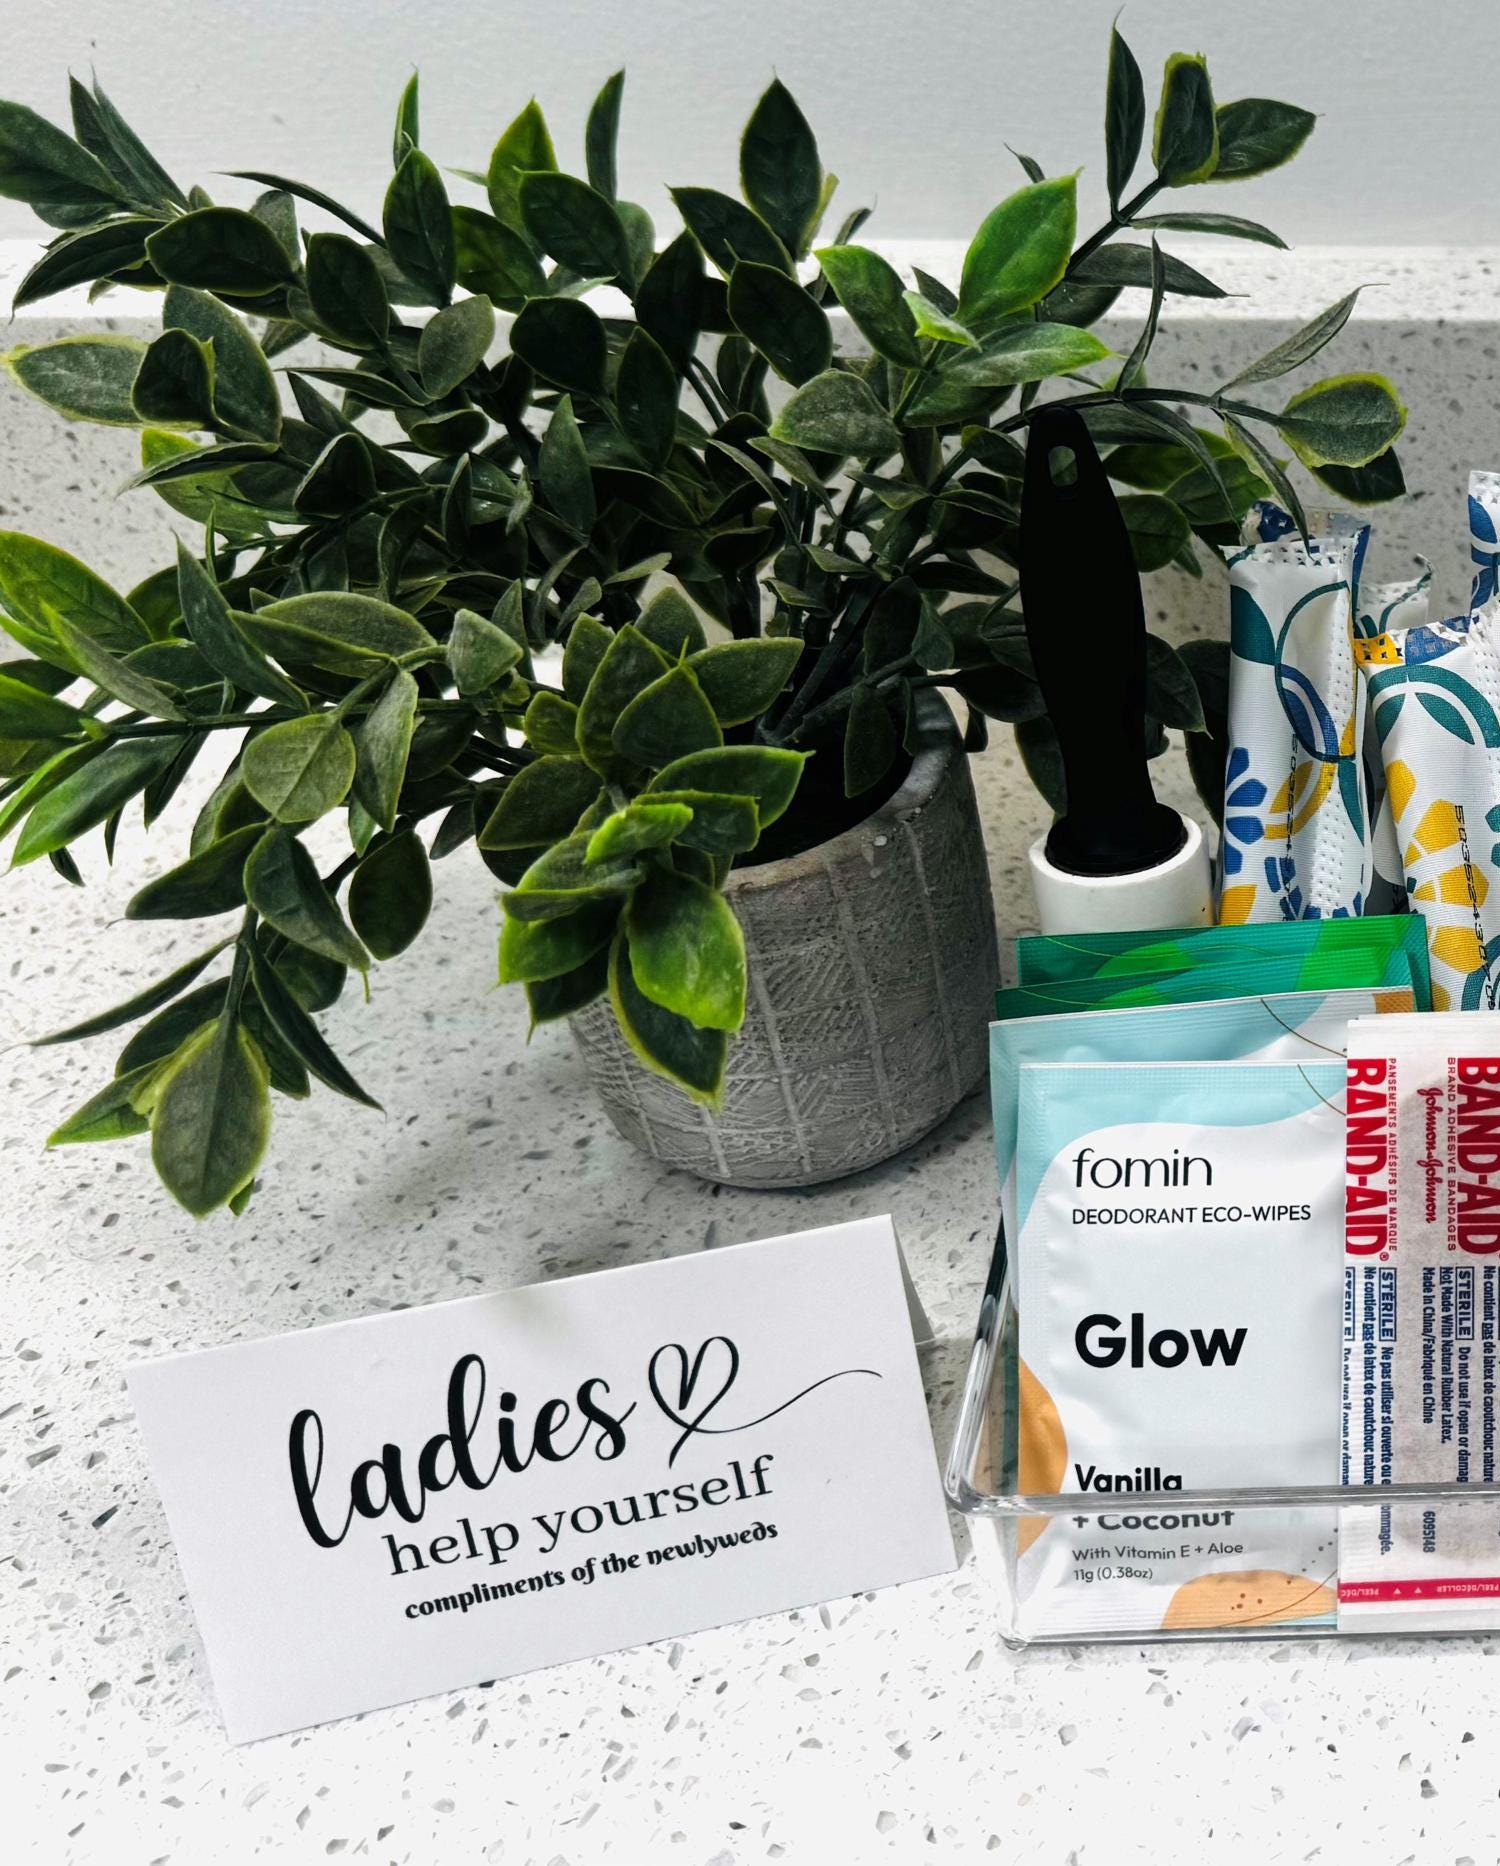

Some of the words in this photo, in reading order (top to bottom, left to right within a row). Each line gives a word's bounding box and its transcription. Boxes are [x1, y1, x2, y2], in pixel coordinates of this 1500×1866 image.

[1388, 1058, 1398, 1128] PANSEMENTS
[1447, 1057, 1456, 1102] BRAND
[1346, 1058, 1388, 1256] BAND-AID
[1447, 1108, 1456, 1174] ADHESIVE
[1072, 1148, 1213, 1189] fomin
[1388, 1132, 1398, 1185] ADHÉSIFS
[1388, 1189, 1398, 1203] DE
[1072, 1207, 1198, 1225] DEODORANT
[1202, 1204, 1312, 1223] ECO-WIPES
[1388, 1206, 1398, 1252] MARQUE
[1447, 1180, 1456, 1252] BANDAGES
[1422, 1267, 1436, 1293] Made
[1440, 1267, 1454, 1285] Not
[1484, 1266, 1496, 1280] Ne
[1364, 1282, 1376, 1322] contient
[1441, 1287, 1454, 1312] Made
[1458, 1270, 1470, 1336] STERILE
[1484, 1281, 1496, 1321] contient
[1074, 1313, 1248, 1369] Glow
[1362, 1323, 1374, 1340] pas
[1441, 1315, 1454, 1338] With
[1482, 1322, 1494, 1340] pas
[1364, 1357, 1376, 1381] latex
[1441, 1340, 1454, 1374] Natural
[1458, 1346, 1470, 1360] Do
[1484, 1356, 1496, 1380] latex
[1458, 1362, 1470, 1380] not
[1381, 1381, 1394, 1414] utiliser
[1441, 1377, 1454, 1412] Rubber
[1458, 1382, 1468, 1399] use
[1364, 1397, 1376, 1452] caoutchouc
[1422, 1397, 1436, 1424] Chine
[1457, 1410, 1468, 1434] open
[1484, 1396, 1496, 1451] caoutchouc
[1381, 1426, 1394, 1463] ouverte
[1441, 1414, 1454, 1444] Latex.
[288, 1353, 638, 1550] ladies
[1074, 1464, 1183, 1492] Vanilla
[382, 1518, 520, 1577] help
[532, 1454, 775, 1553] yourself
[1072, 1515, 1089, 1529] +
[1098, 1510, 1236, 1530] Coconut
[1423, 1510, 1436, 1553] 6095148
[1072, 1546, 1110, 1562] With
[1114, 1545, 1176, 1560] Vitamin
[1180, 1544, 1191, 1558] E
[1194, 1545, 1204, 1554] +
[1208, 1542, 1244, 1555] Aloe
[404, 1568, 566, 1620] compliments
[571, 1559, 600, 1585] of
[601, 1550, 642, 1578] the
[646, 1521, 780, 1566] newlyweds
[1073, 1568, 1094, 1582] 11g
[1097, 1566, 1154, 1581] (0.38oz)
